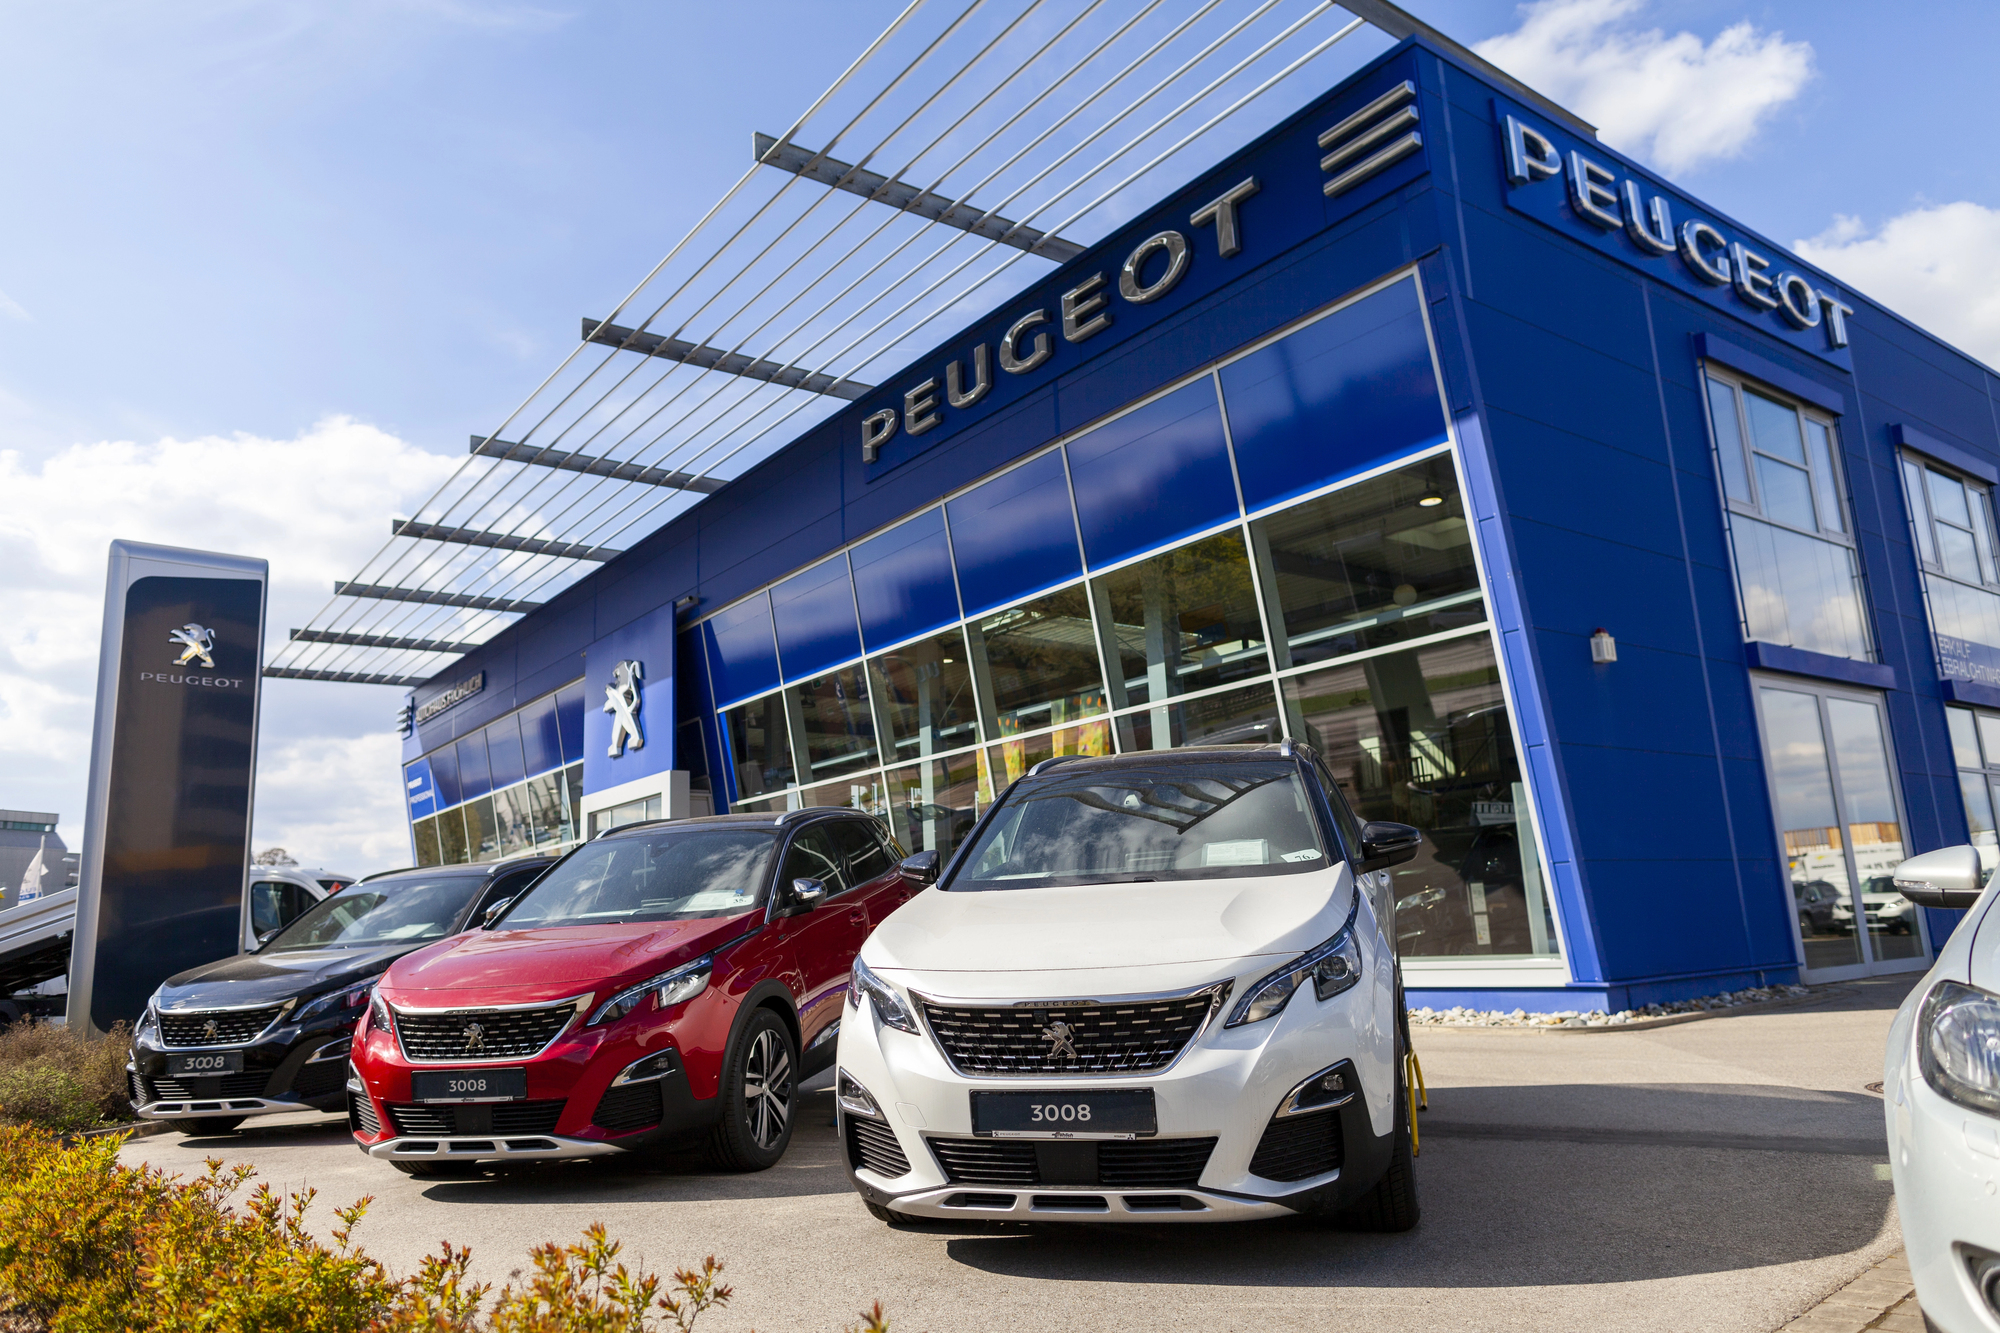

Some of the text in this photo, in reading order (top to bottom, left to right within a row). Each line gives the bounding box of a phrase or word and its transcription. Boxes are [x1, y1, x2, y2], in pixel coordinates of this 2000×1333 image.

[1501, 114, 1854, 349] PEUGEOT
[862, 175, 1260, 465] PEUGEOT
[1938, 637, 1971, 658] ERKAUF
[140, 672, 242, 689] PEUGEOT
[184, 1055, 225, 1070] 3008
[448, 1079, 487, 1093] 3008
[1030, 1104, 1092, 1122] 3008
